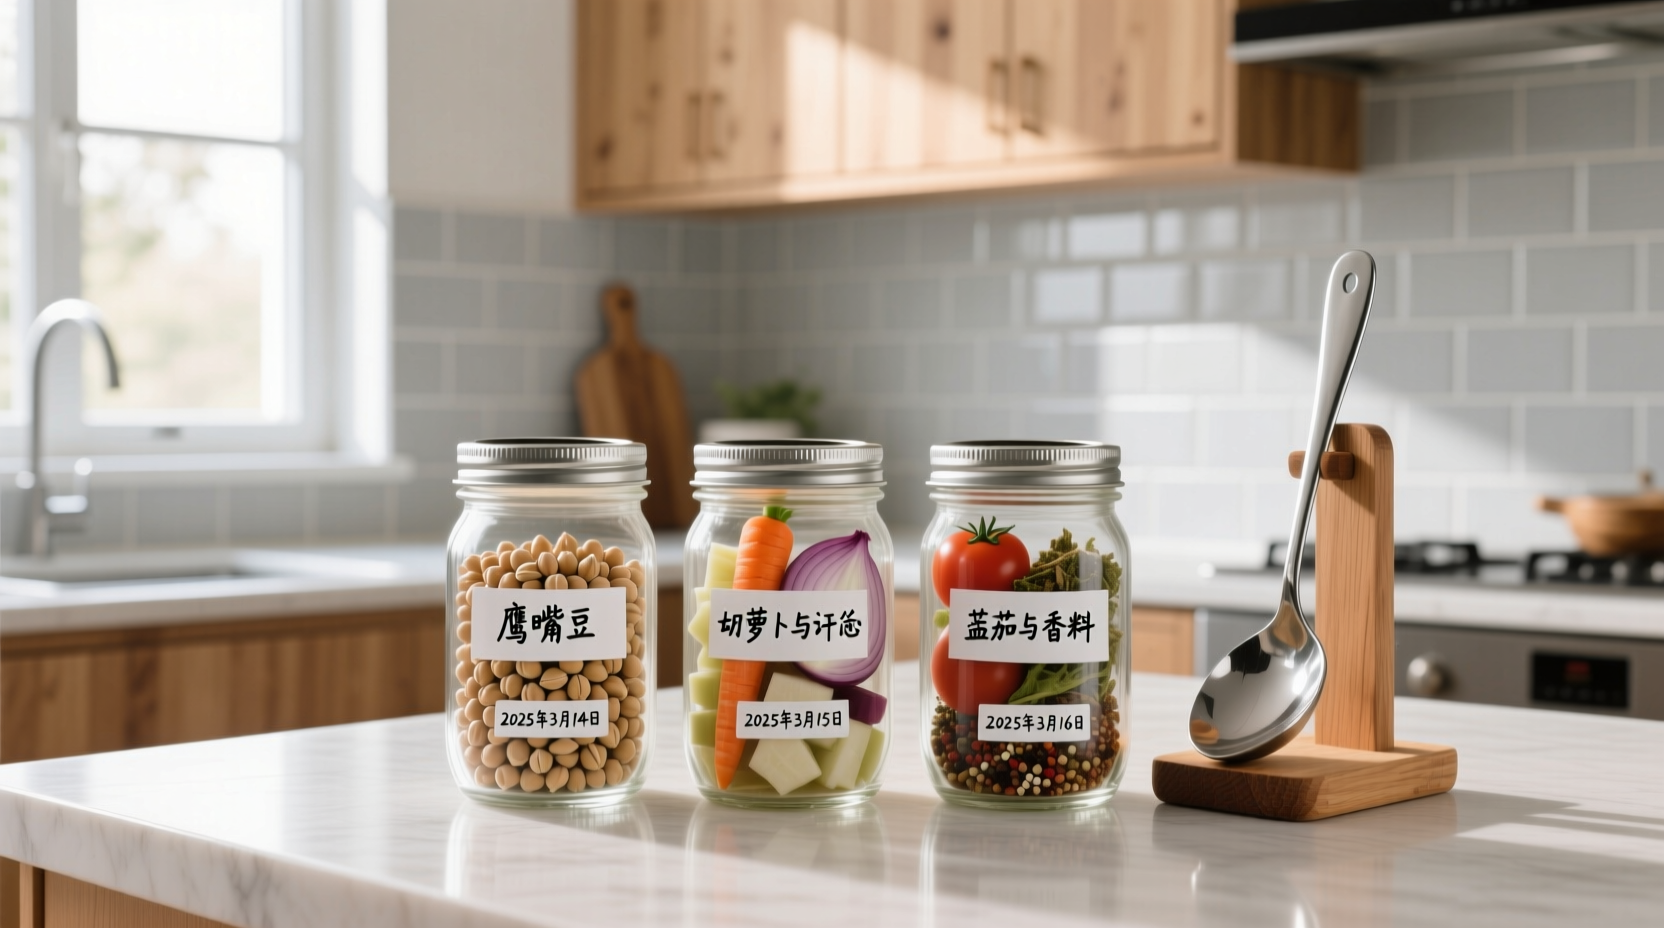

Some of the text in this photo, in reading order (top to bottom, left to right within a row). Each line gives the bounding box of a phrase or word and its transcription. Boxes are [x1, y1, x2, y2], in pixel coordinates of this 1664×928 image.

[496, 601, 596, 645] 鹰嘴豆
[500, 709, 600, 729] 2025年3月14日
[744, 709, 842, 730] 2025年3月15日
[985, 713, 1084, 733] 2025年3月16日
